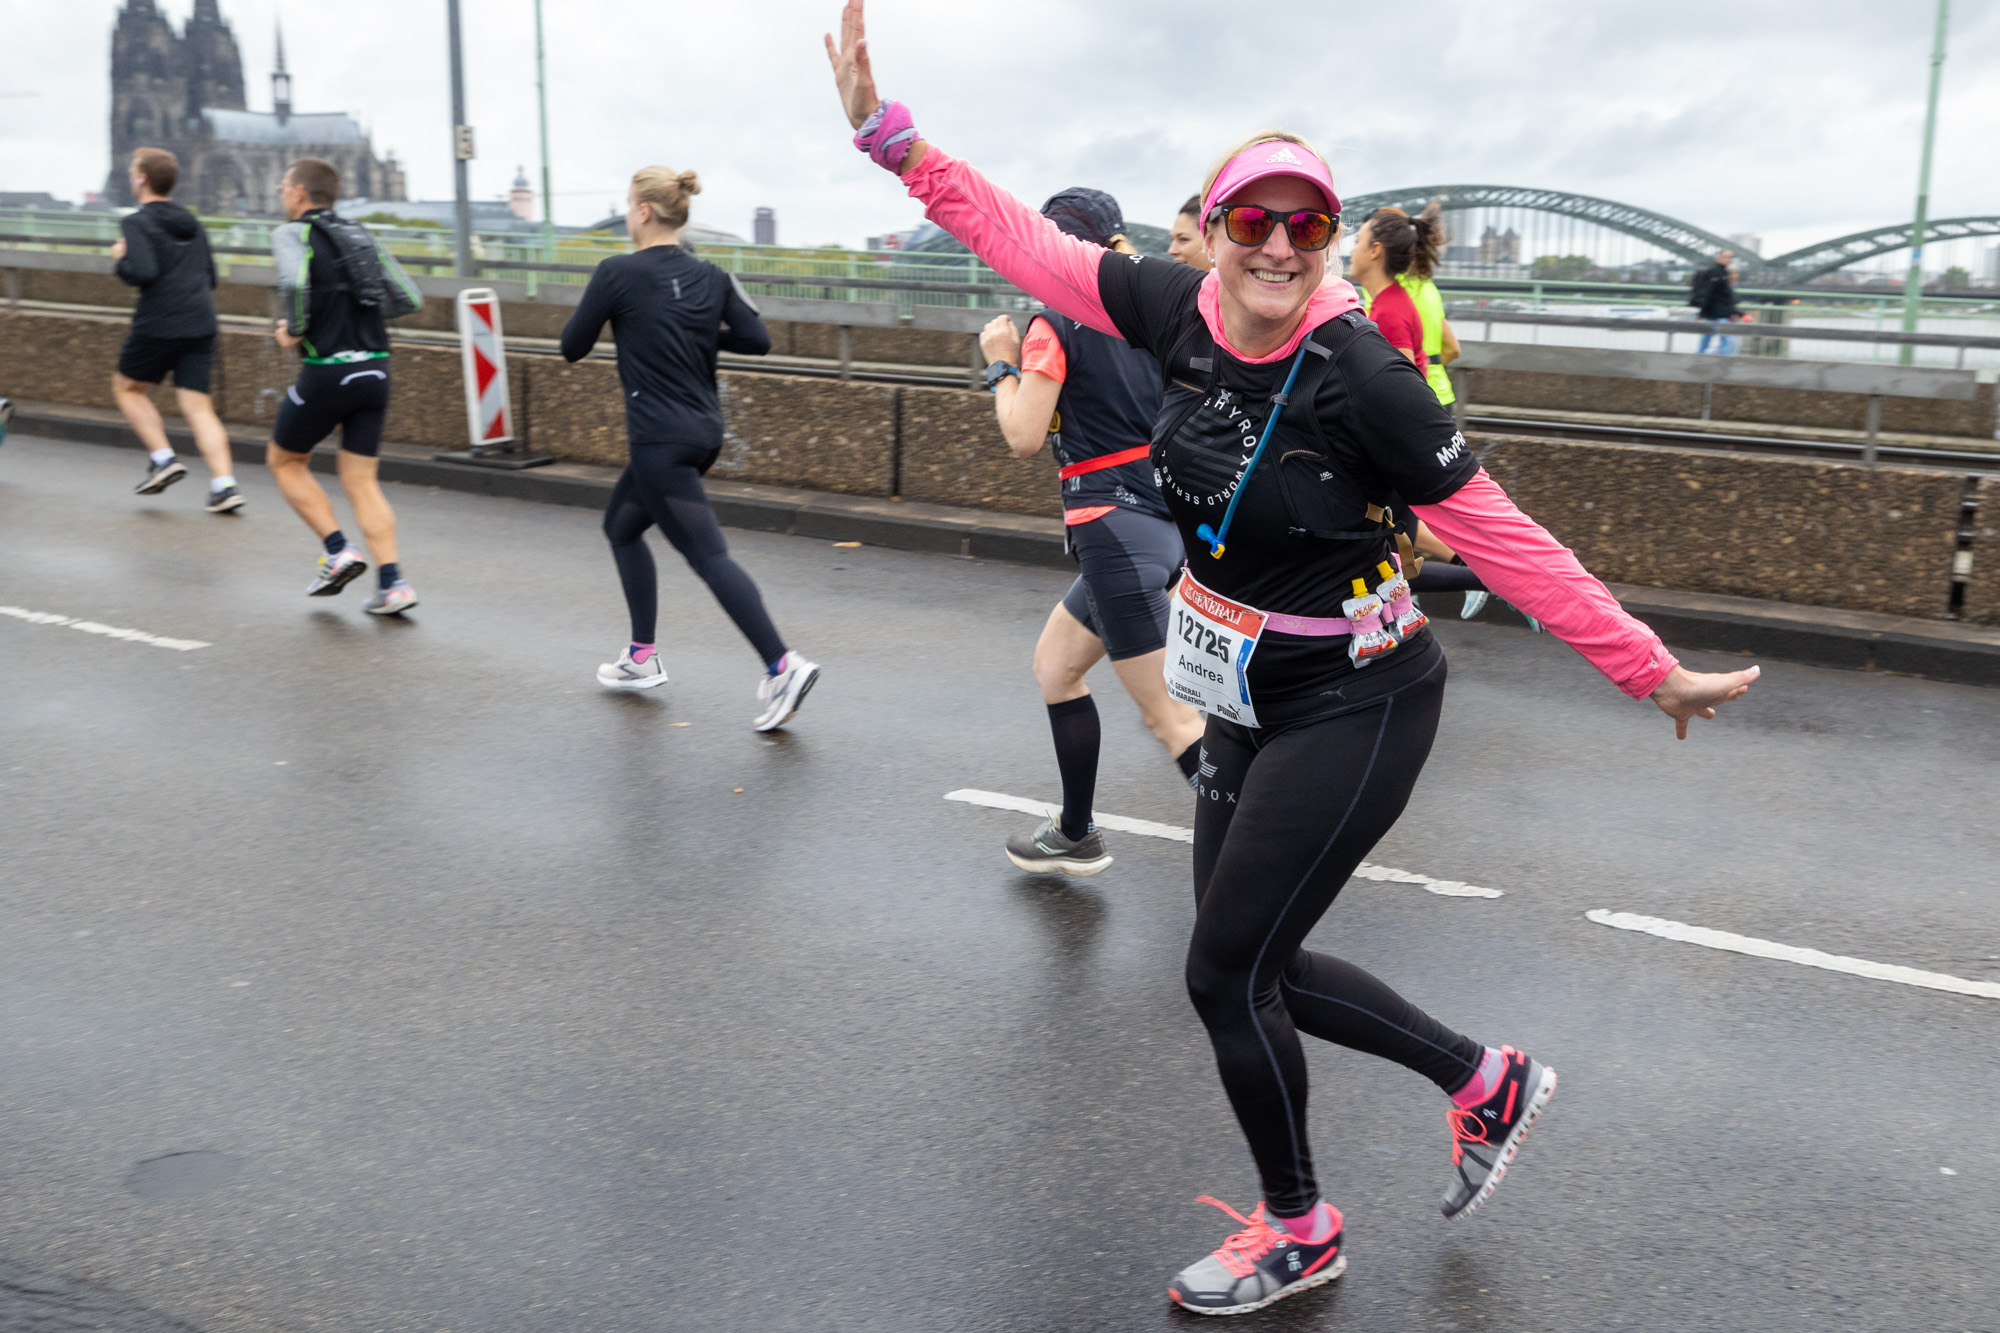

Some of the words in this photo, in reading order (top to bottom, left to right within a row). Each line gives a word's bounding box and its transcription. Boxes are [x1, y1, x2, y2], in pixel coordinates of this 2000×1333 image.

[1266, 157, 1302, 166] adidas
[1214, 398, 1257, 466] HYROX
[1162, 465, 1200, 505] SERIES
[1207, 470, 1246, 506] WORLD
[1192, 590, 1243, 625] GENERALI
[1178, 609, 1232, 664] 12725
[1178, 654, 1225, 685] Andrea
[1175, 682, 1201, 698] GENERALI
[1175, 691, 1207, 708] MARATHON
